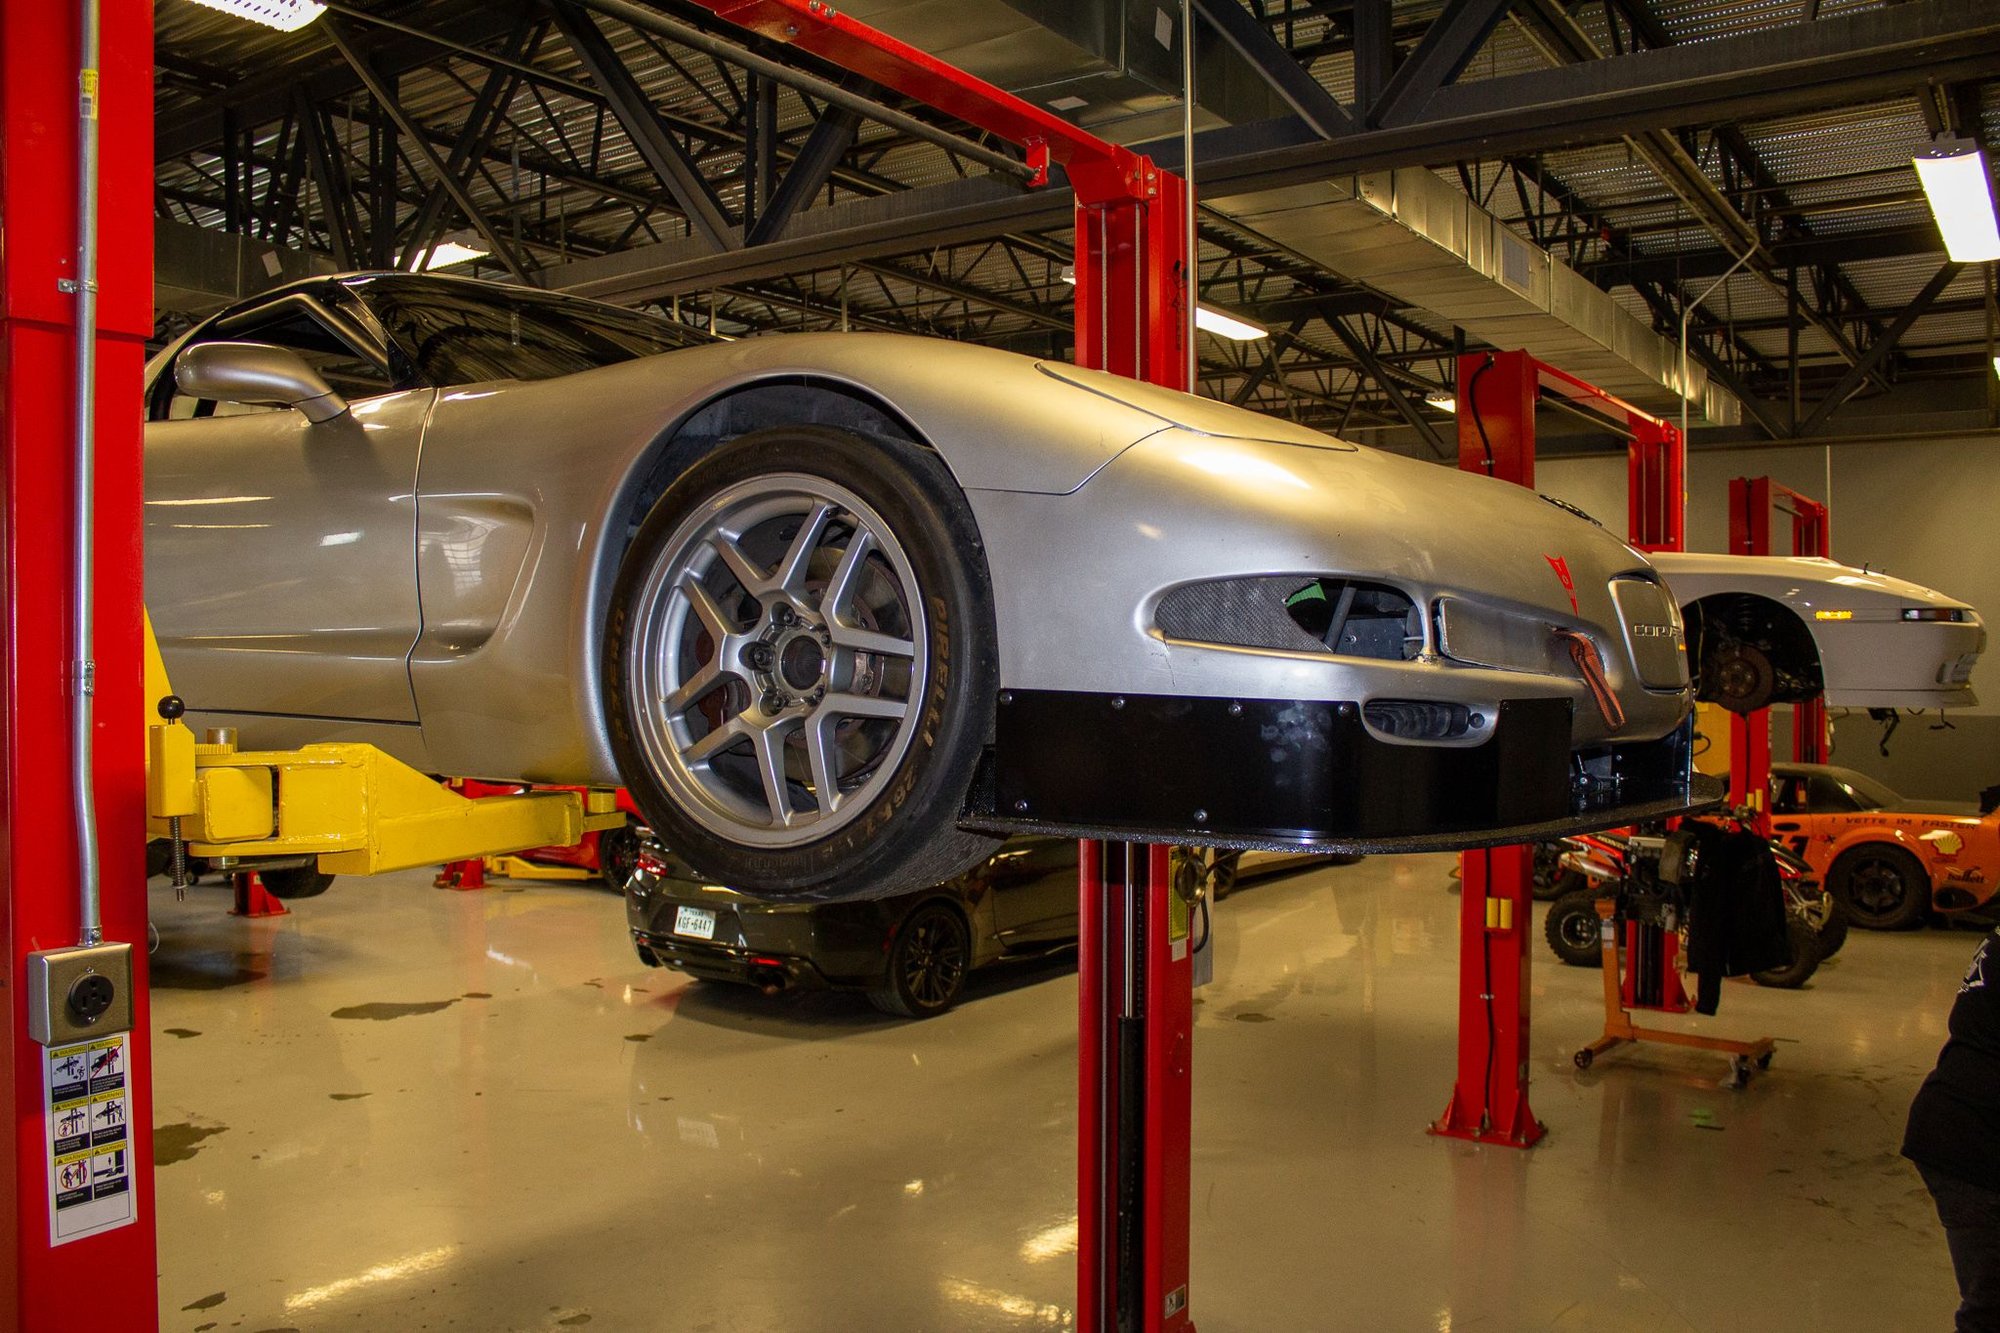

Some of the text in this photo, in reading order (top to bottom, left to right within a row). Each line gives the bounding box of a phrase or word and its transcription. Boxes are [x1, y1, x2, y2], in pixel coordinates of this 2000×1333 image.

[922, 596, 949, 747] PIRELLI
[1922, 819, 1976, 830] FASTER
[97, 1038, 121, 1047] WARNING
[59, 1046, 85, 1056] WARNING
[98, 1090, 124, 1100] WARNING
[61, 1098, 88, 1109] WARNING
[100, 1142, 126, 1153] WARNING
[64, 1151, 91, 1162] WARNING
